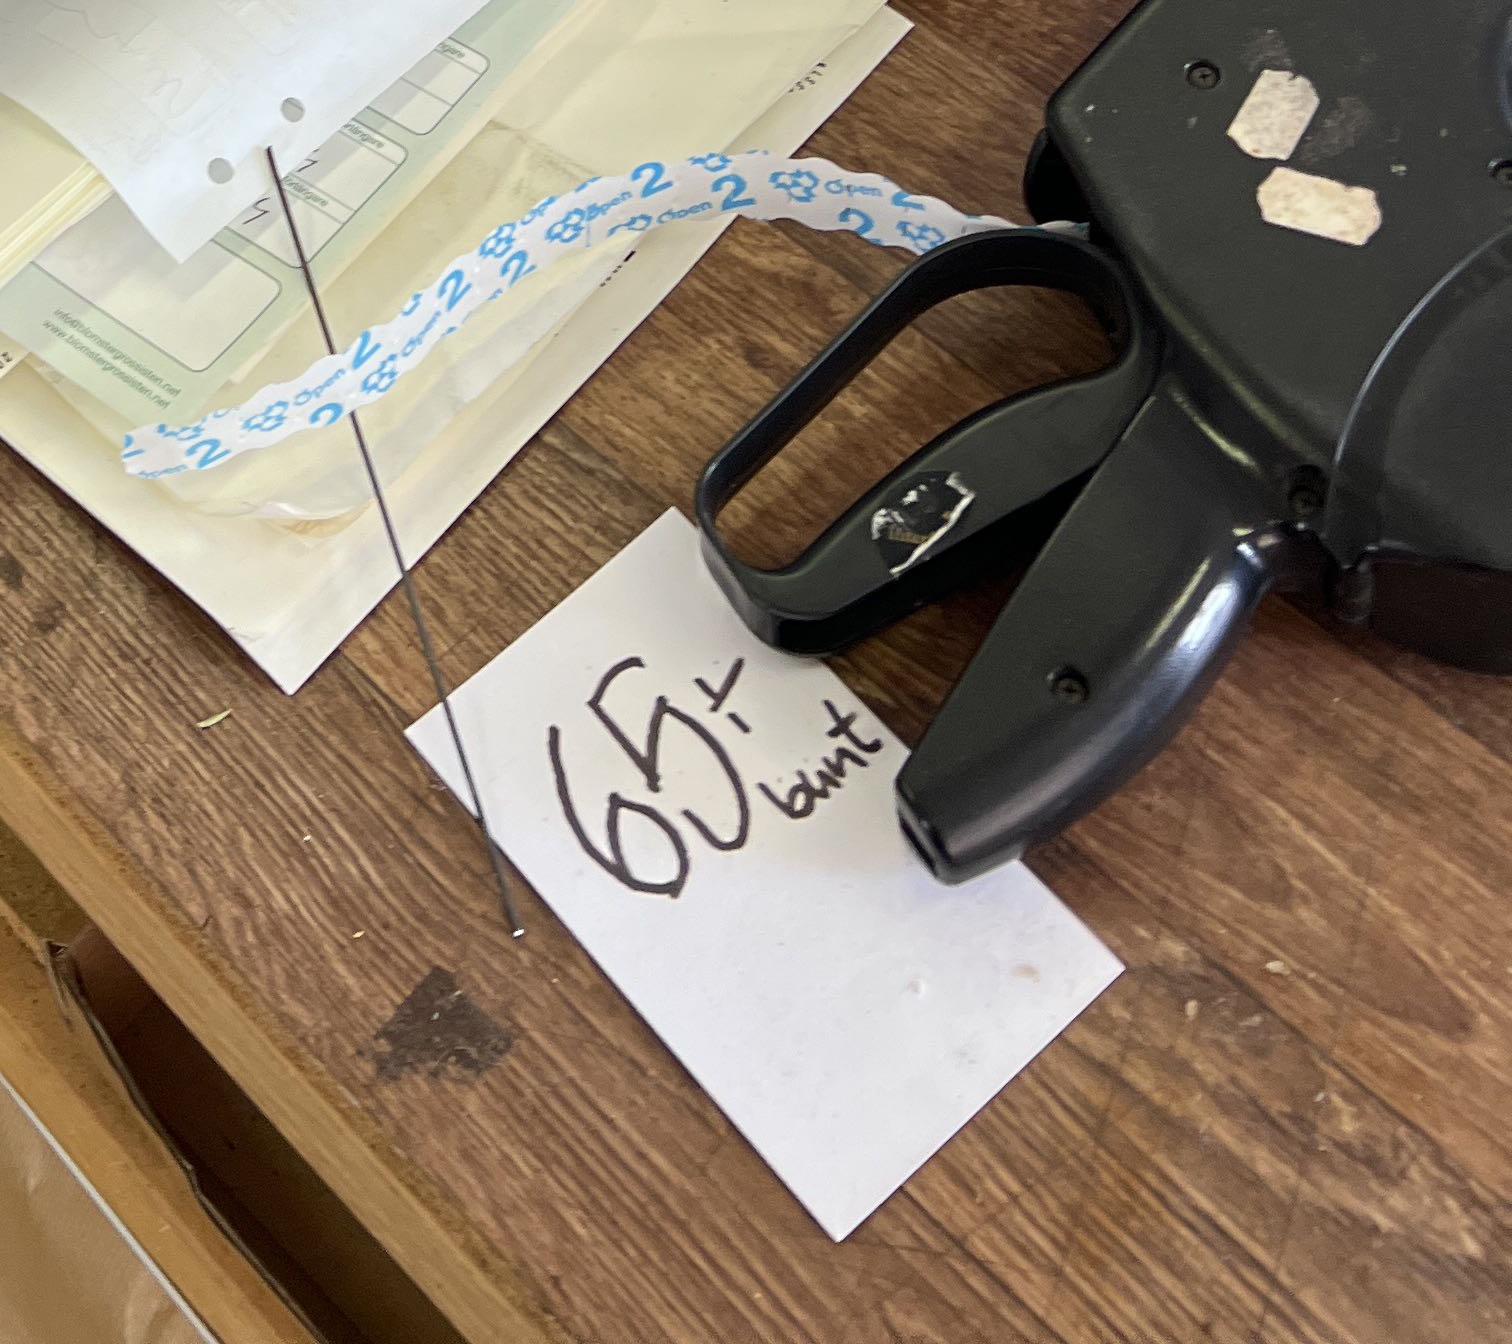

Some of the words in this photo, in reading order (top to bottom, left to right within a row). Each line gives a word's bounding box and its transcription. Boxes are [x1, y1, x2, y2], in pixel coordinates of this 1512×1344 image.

[630, 161, 674, 199] 2
[710, 173, 757, 212] 2
[499, 249, 538, 287] 2
[438, 268, 472, 311] 2
[41, 319, 172, 410] www.blomstergrossisten.net
[185, 438, 232, 470] 2
[758, 699, 884, 821] bunt
